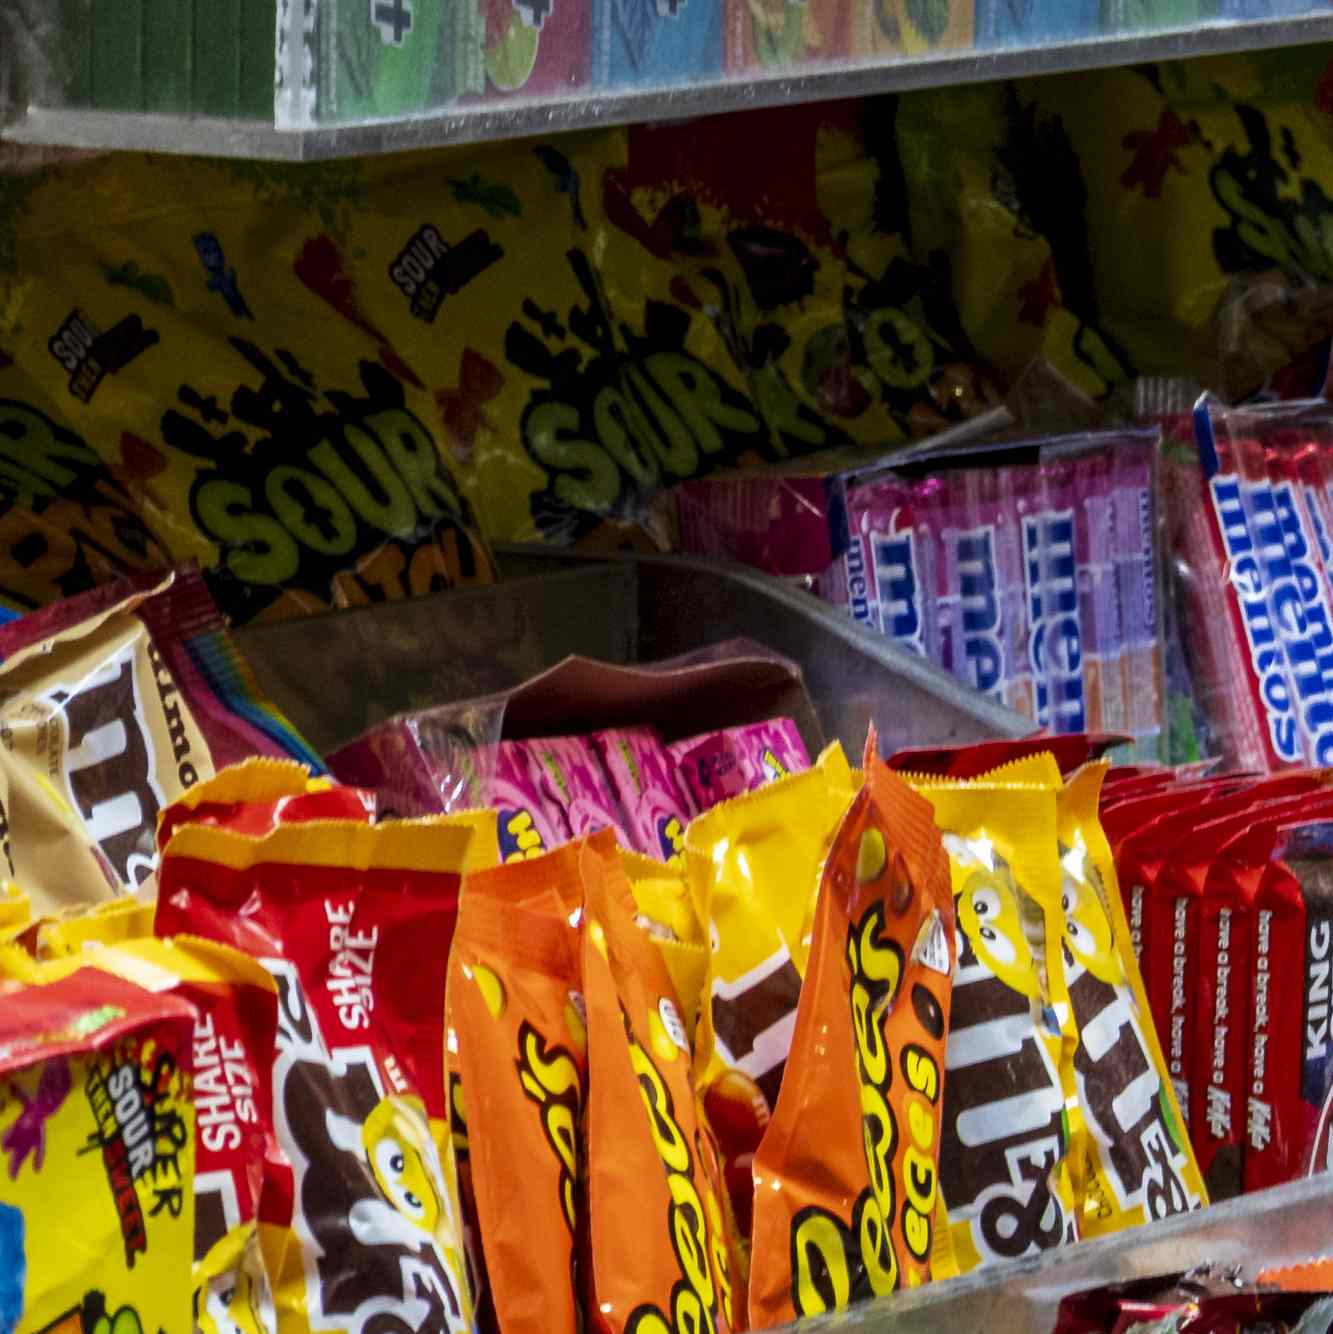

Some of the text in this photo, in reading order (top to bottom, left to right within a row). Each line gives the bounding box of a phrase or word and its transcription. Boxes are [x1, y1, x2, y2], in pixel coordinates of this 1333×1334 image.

[196, 408, 465, 586] SOUR
[530, 353, 753, 503] SOUR
[1211, 473, 1302, 762] mentos
[1305, 926, 1331, 1062] KING
[108, 1063, 156, 1180] SOUR
[219, 1034, 258, 1124] SIZE
